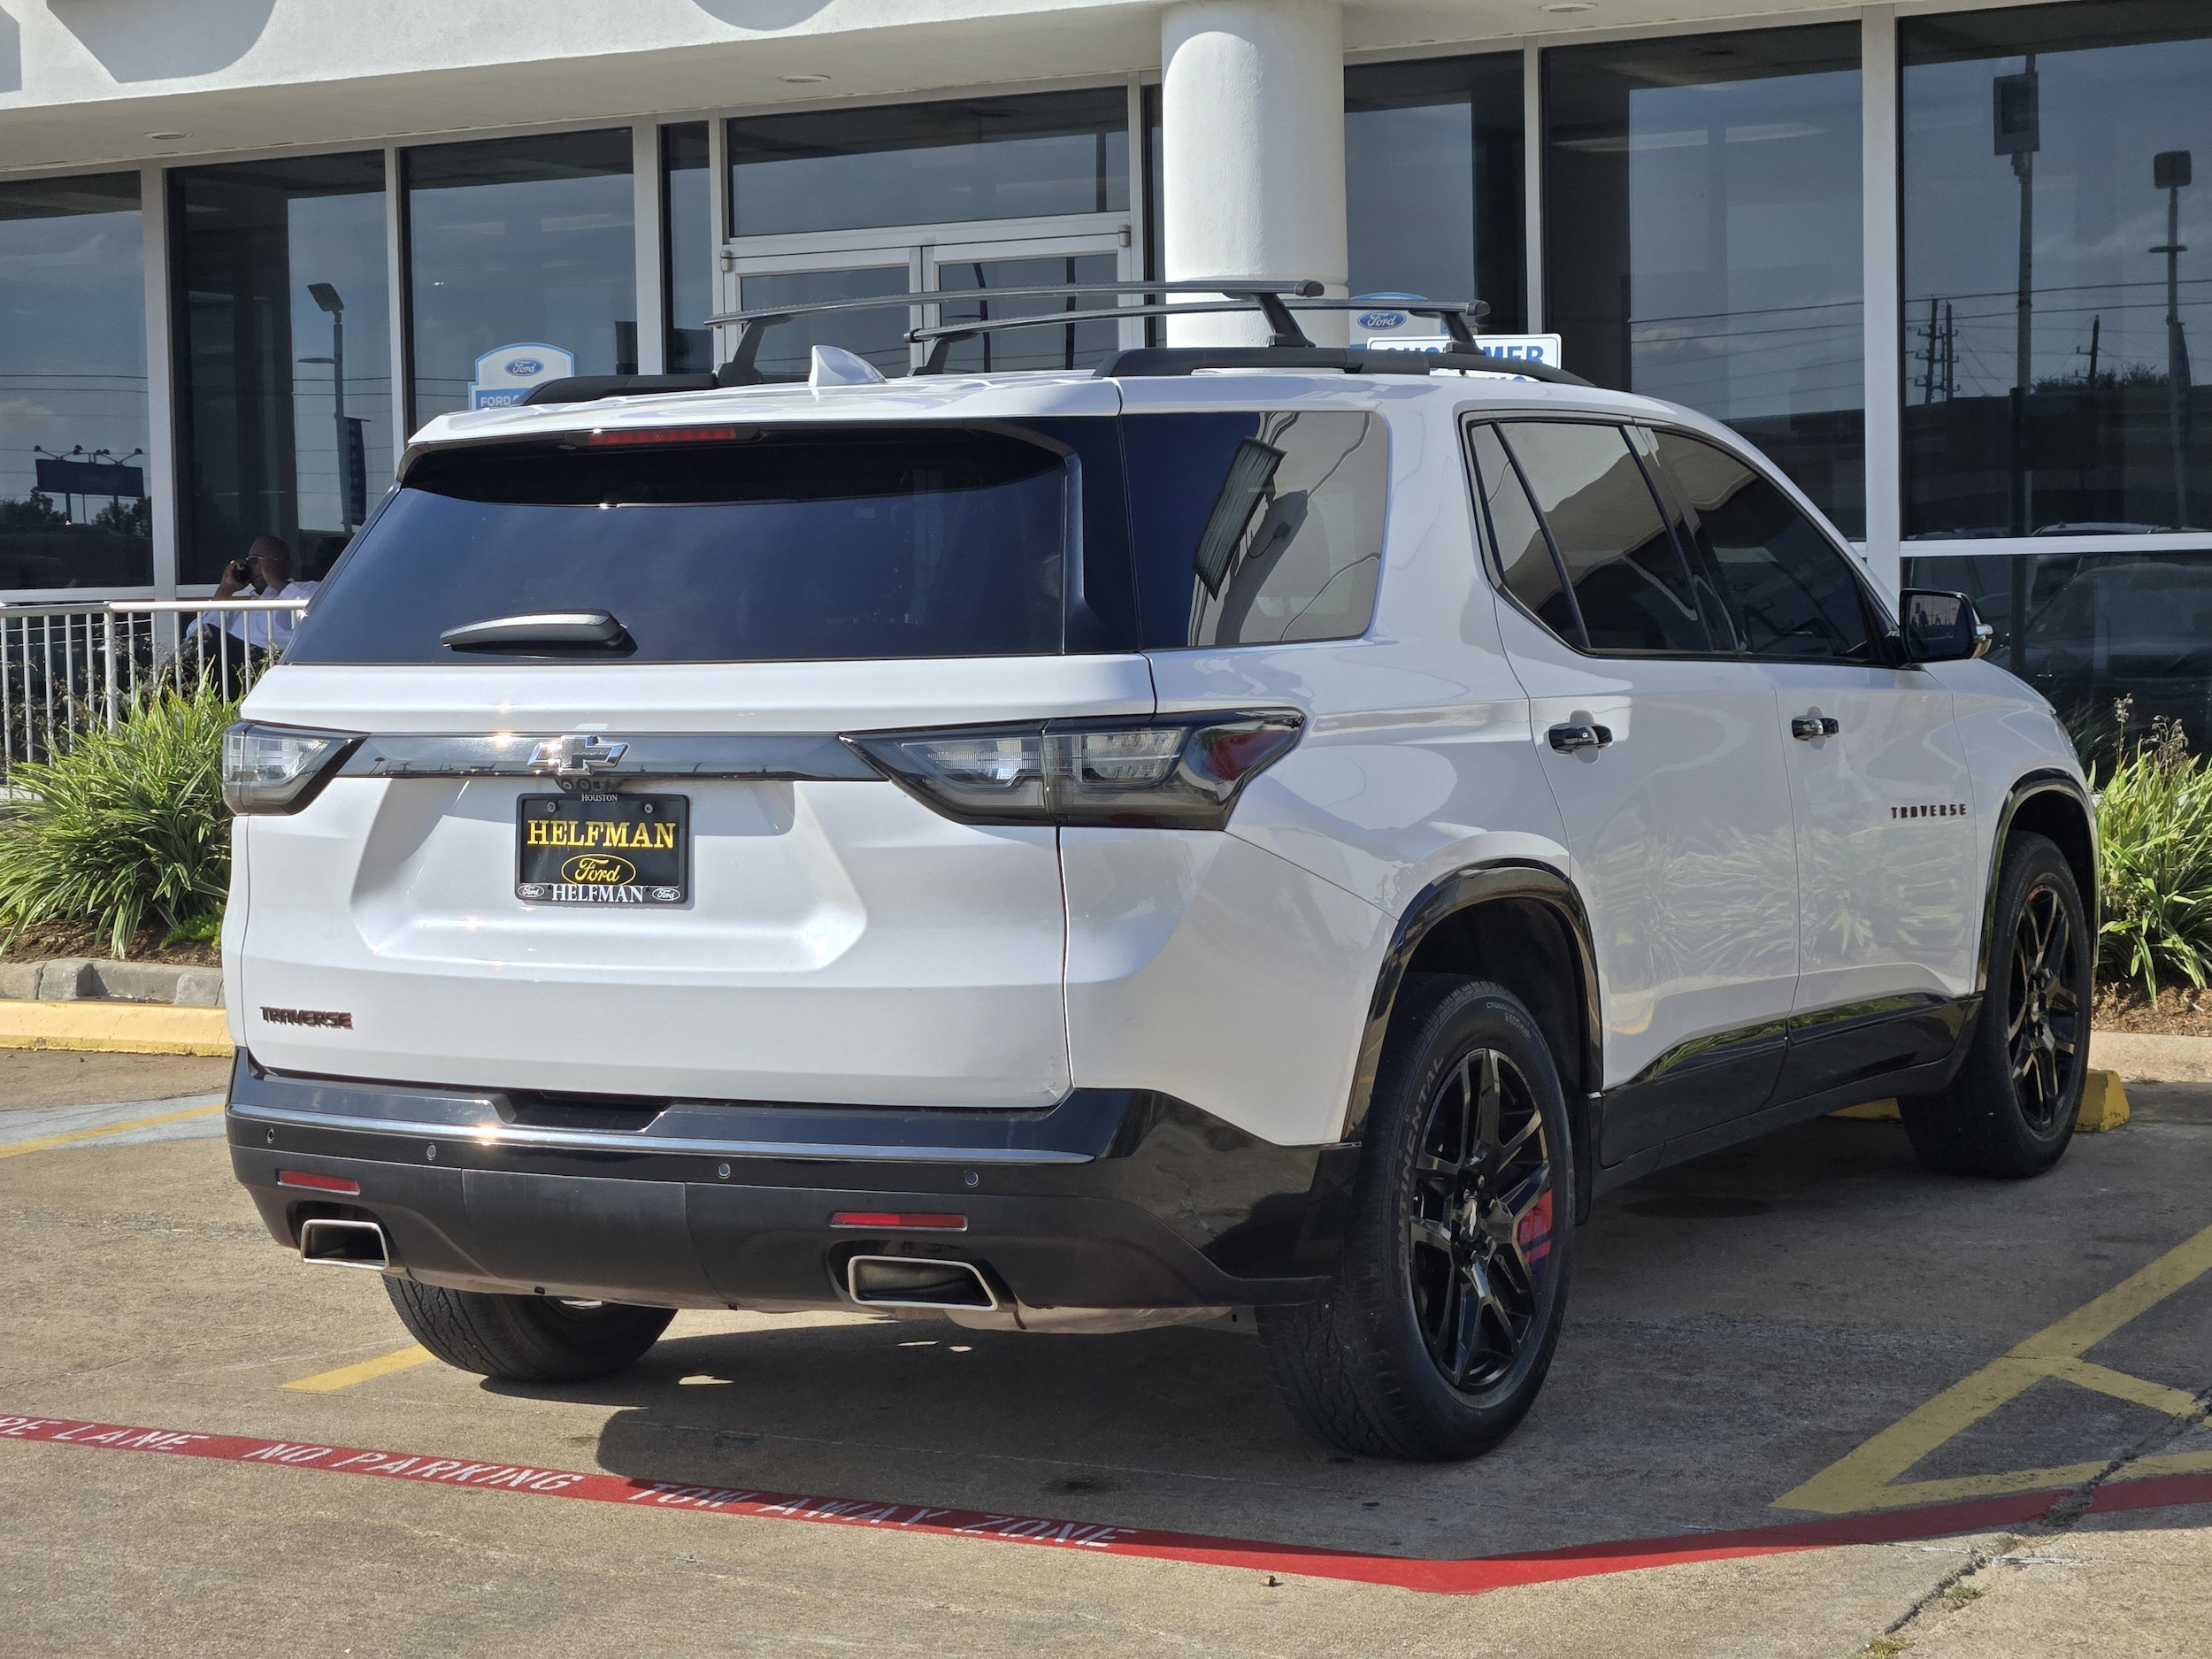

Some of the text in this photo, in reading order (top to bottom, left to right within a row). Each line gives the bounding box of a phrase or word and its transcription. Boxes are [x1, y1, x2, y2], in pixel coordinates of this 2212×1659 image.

[1367, 312, 1397, 327] Ford
[512, 360, 536, 373] Ford
[480, 396, 511, 407] FORD
[1891, 803, 1966, 819] TRAVERSE
[527, 819, 676, 849] HELFMAN
[575, 857, 621, 883] Ford
[551, 884, 644, 902] HELFMAN
[259, 1006, 354, 1030] TRAVERSE
[0, 1417, 1138, 1548] RE LANE NO PARKING TOW AWAY ZONE
